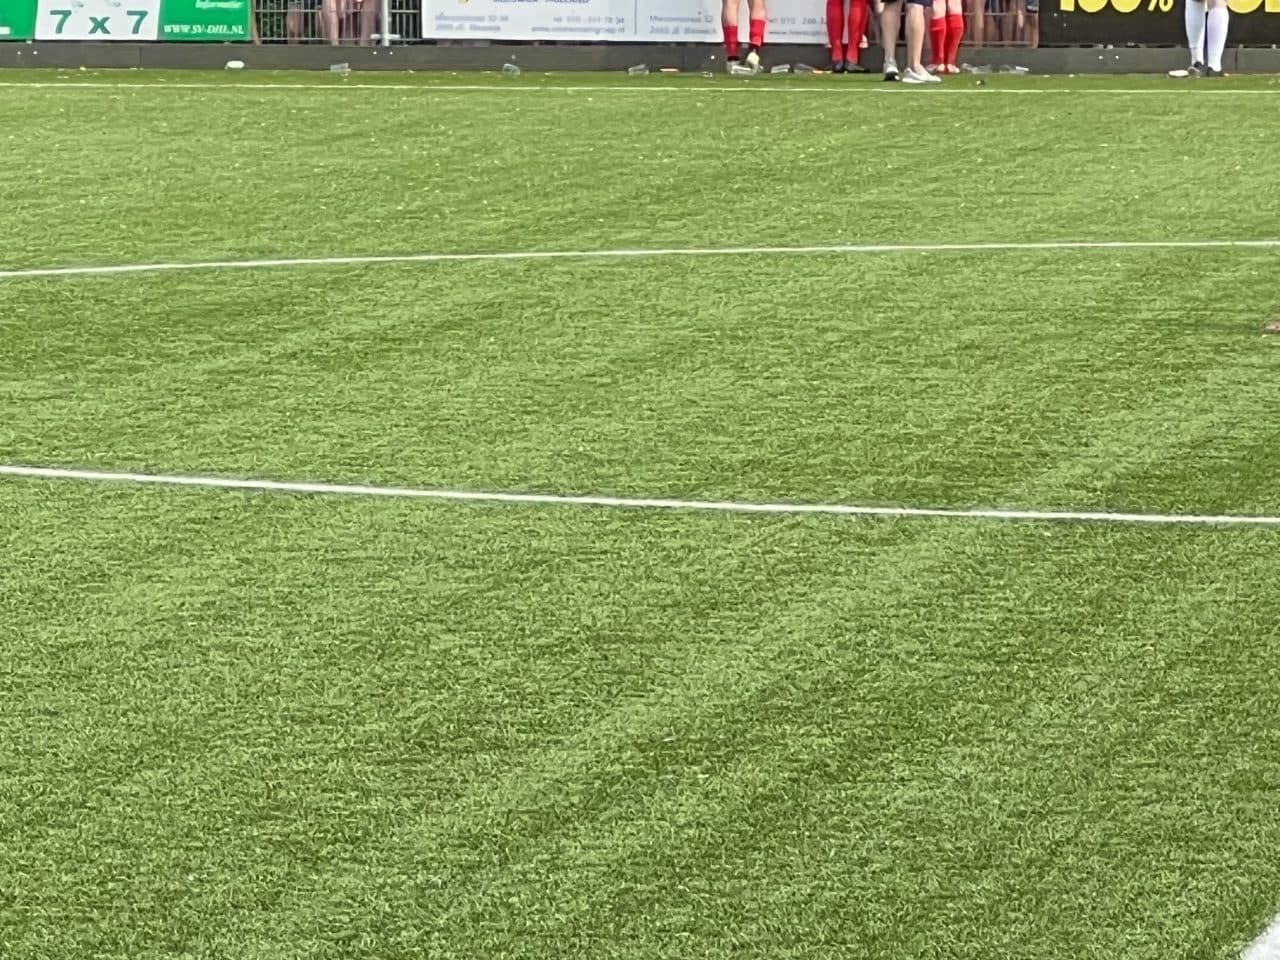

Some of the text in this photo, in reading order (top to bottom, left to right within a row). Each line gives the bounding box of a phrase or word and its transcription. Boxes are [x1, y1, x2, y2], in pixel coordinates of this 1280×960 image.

[49, 10, 149, 34] 7 x 7
